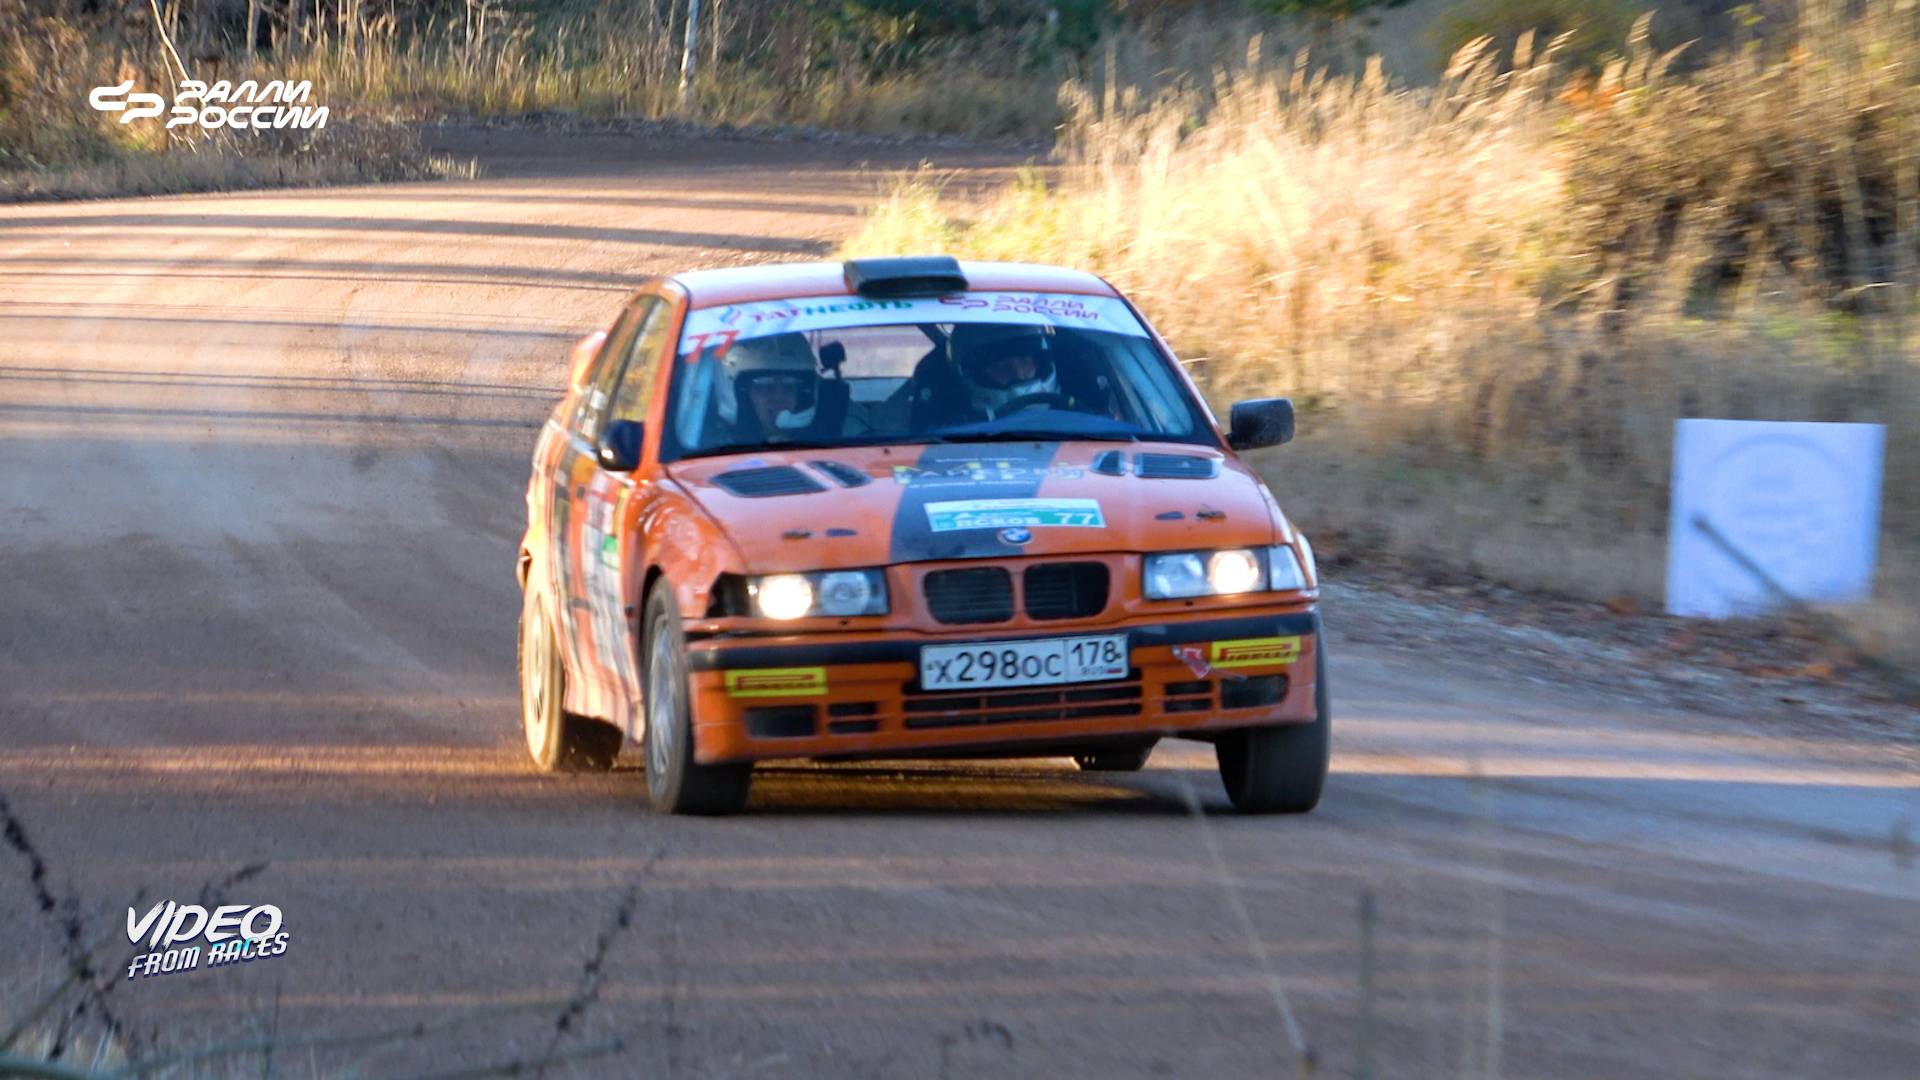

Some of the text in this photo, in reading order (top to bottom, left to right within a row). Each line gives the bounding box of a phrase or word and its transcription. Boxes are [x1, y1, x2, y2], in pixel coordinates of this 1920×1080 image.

[684, 329, 741, 365] 77
[1054, 512, 1096, 526] 77
[1071, 639, 1116, 667] 178
